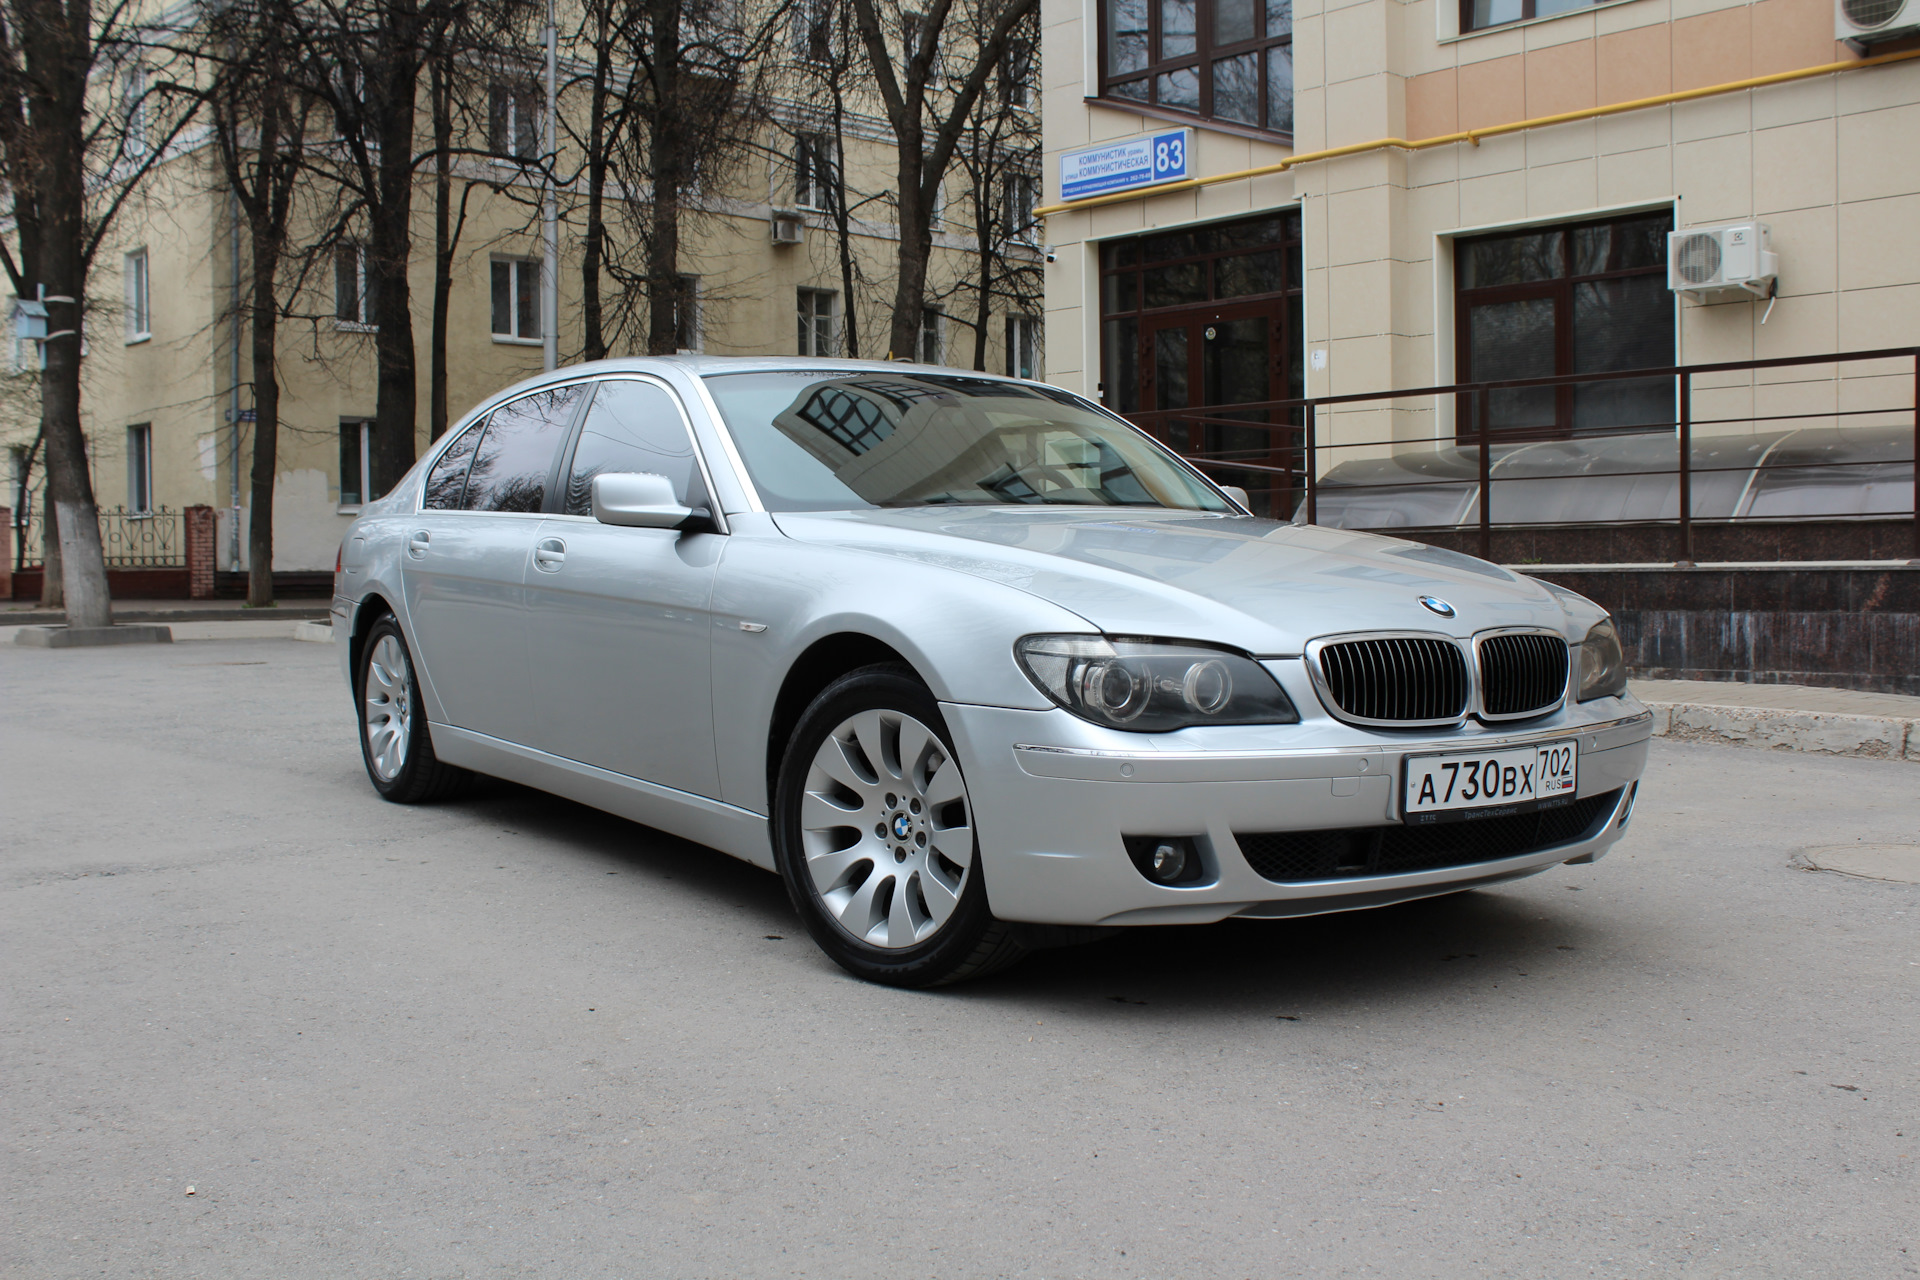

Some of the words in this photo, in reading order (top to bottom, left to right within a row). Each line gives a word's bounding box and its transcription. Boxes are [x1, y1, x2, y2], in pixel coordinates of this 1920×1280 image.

[1065, 172, 1078, 182] улица
[1079, 155, 1148, 177] КОММУНИСТИЧЕСКАЯ
[1079, 147, 1126, 166] КОММУНИСТИК
[1156, 139, 1183, 172] 83
[1539, 747, 1571, 780] 702
[1418, 759, 1534, 805] А730ВХ
[1545, 779, 1561, 791] RUS
